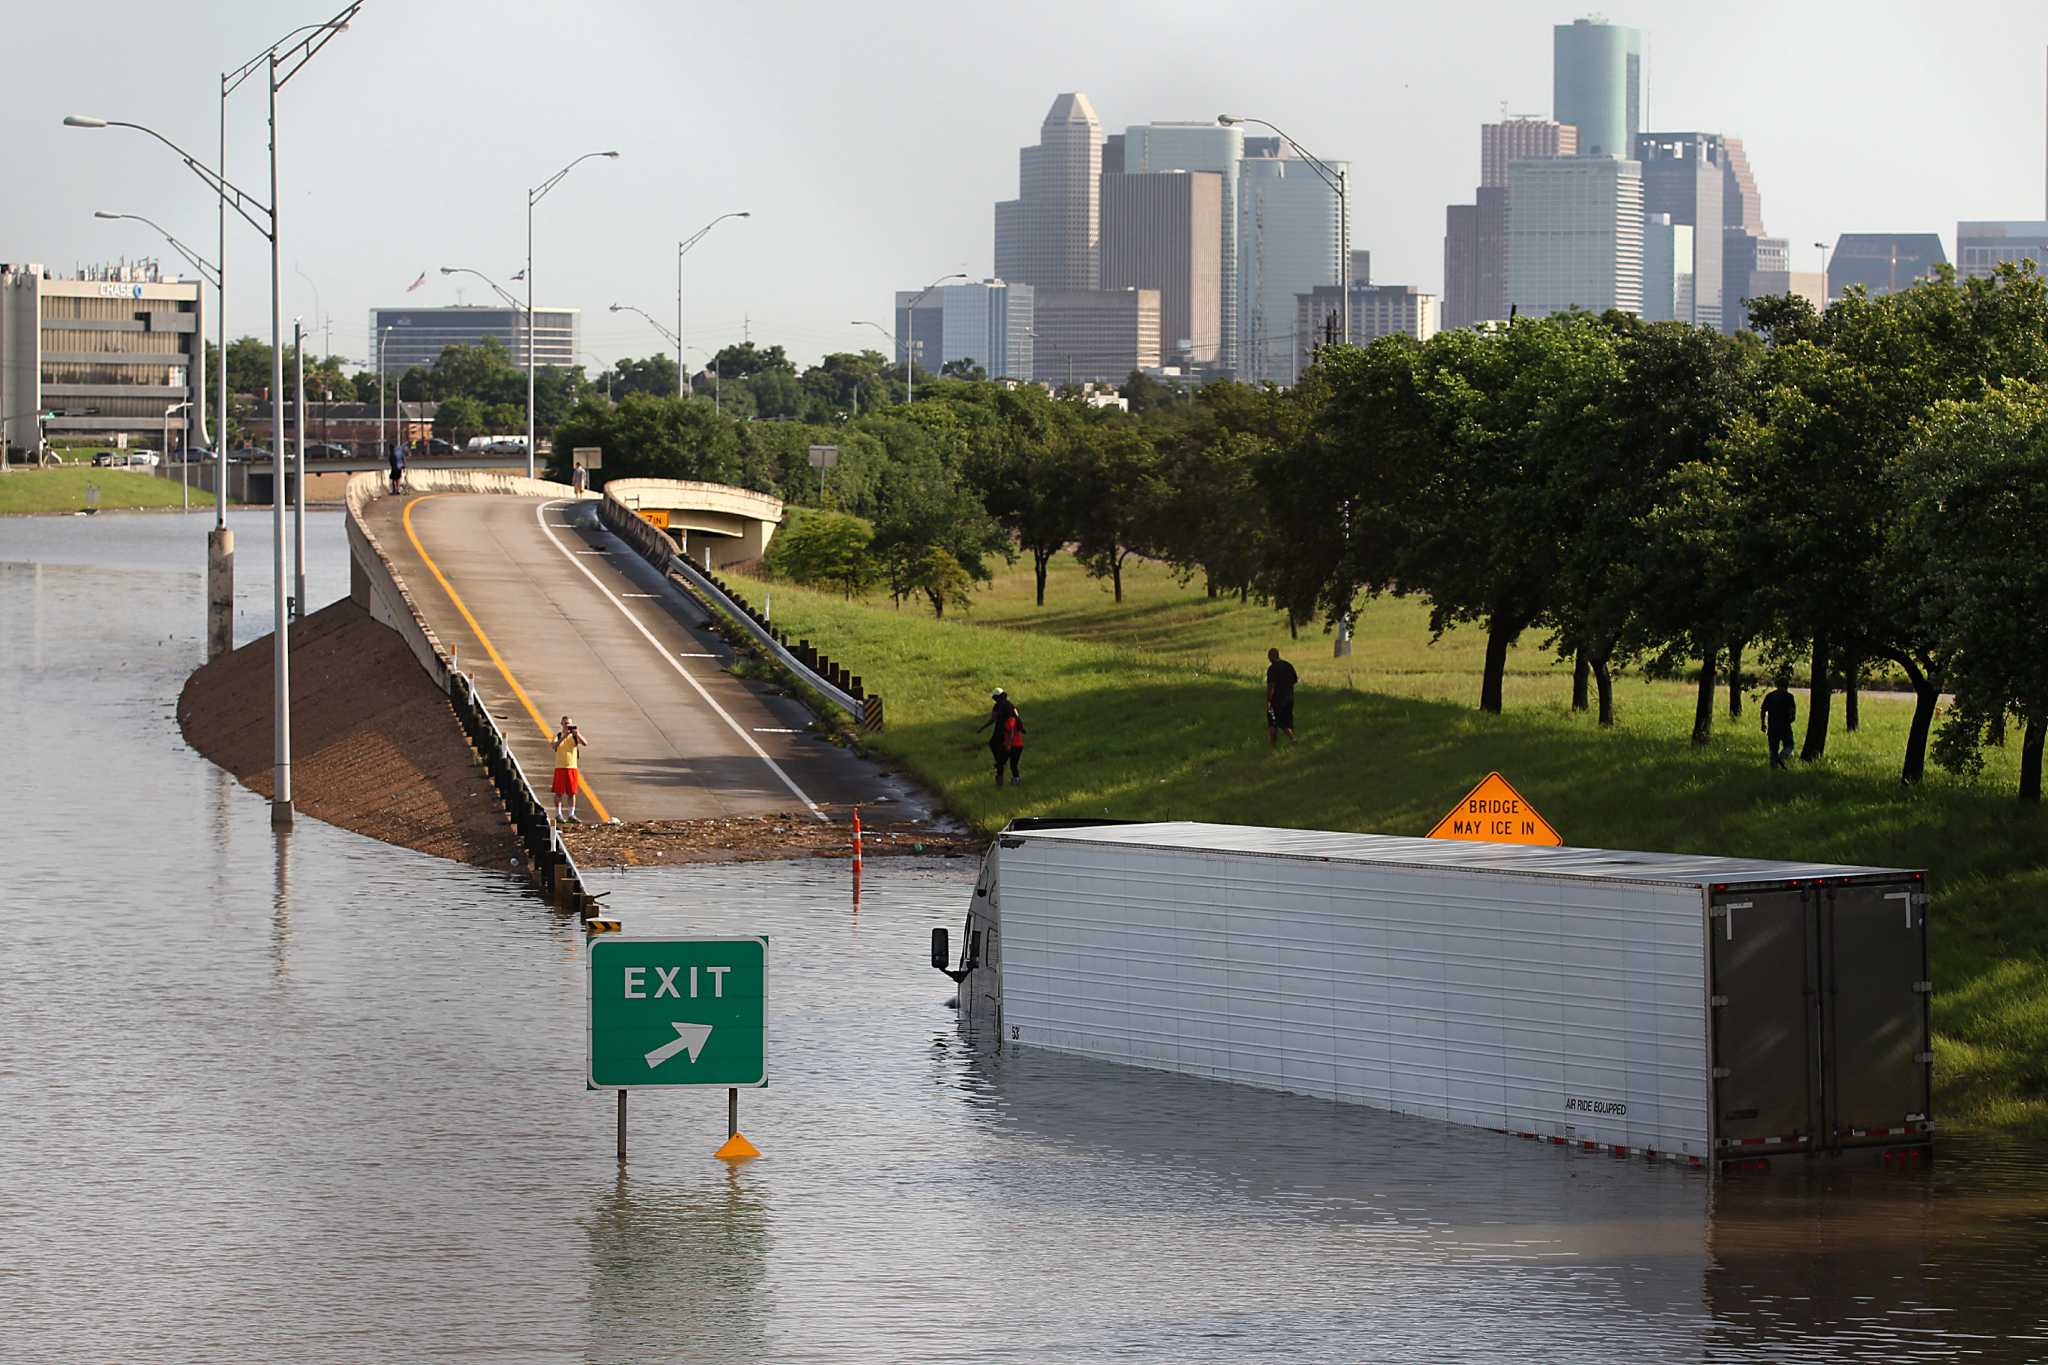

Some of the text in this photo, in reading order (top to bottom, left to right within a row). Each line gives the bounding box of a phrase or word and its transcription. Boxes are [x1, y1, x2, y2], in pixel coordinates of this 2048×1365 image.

[99, 283, 132, 298] CHASE
[1469, 800, 1519, 814] BRIDGE
[1453, 821, 1534, 835] MAY ICE IN
[624, 966, 731, 999] EXIT
[1566, 1098, 1627, 1116] AIR RIDE EQUIPPED
